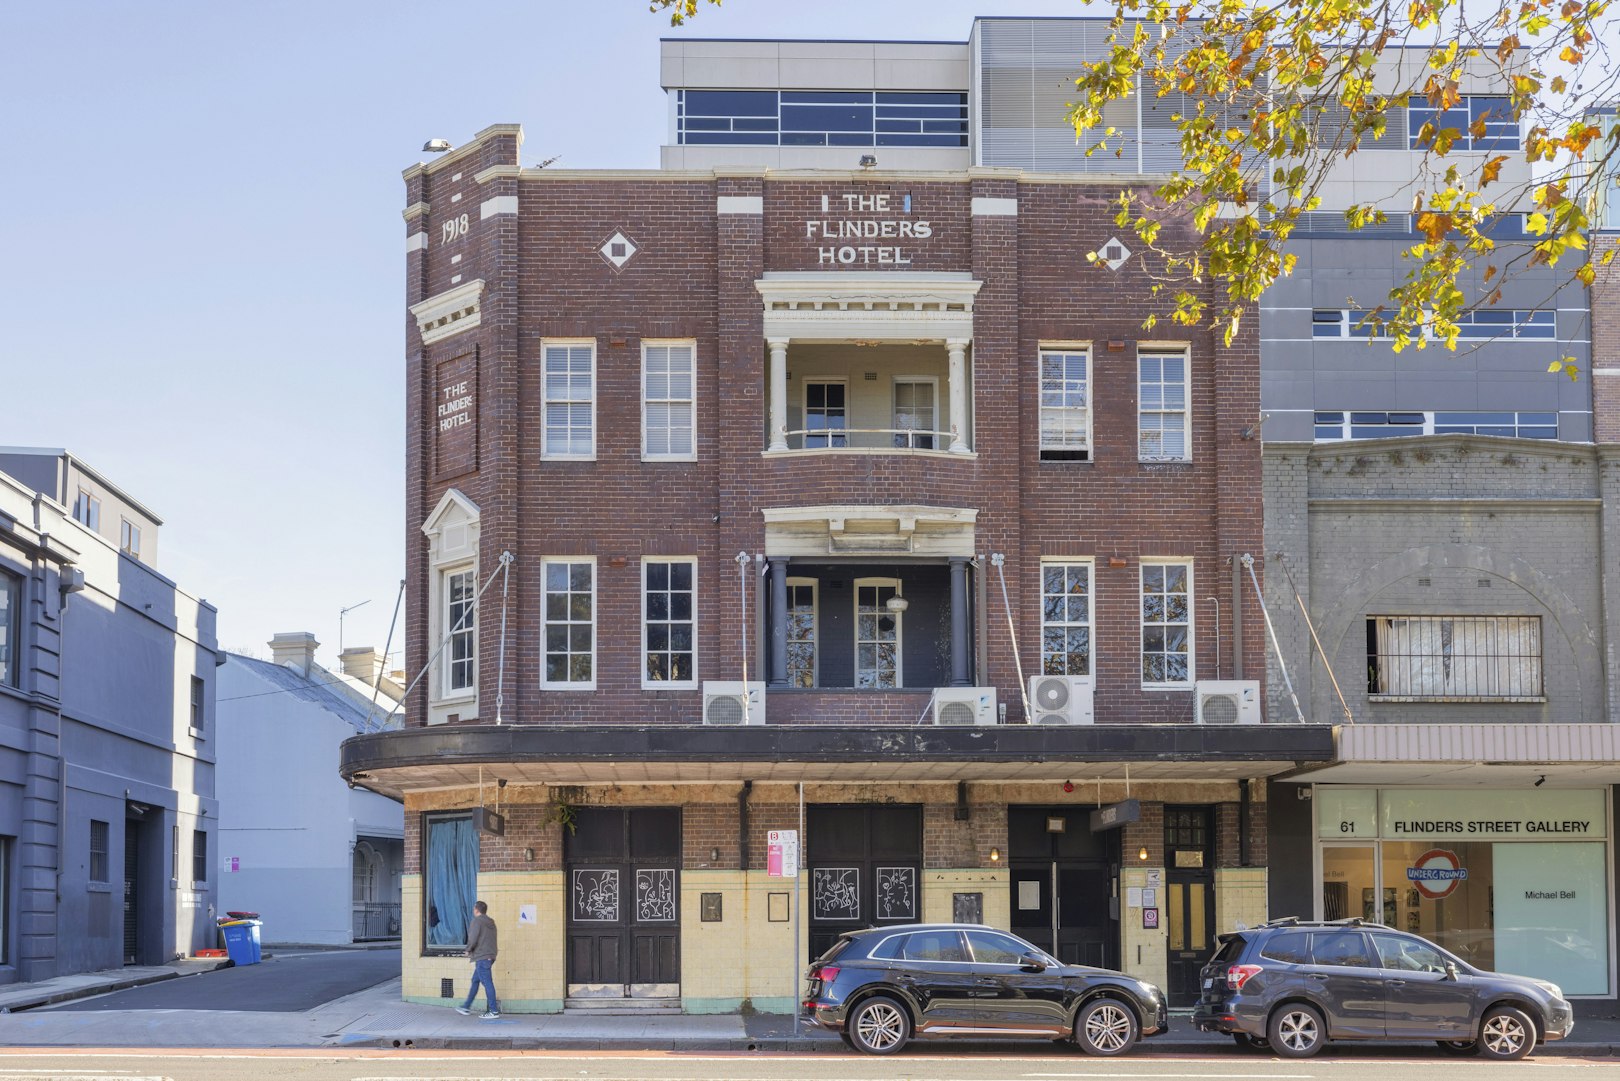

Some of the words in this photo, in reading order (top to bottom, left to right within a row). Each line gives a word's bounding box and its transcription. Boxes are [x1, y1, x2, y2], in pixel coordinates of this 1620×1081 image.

[842, 194, 890, 212] THE
[441, 213, 470, 245] 1918
[806, 220, 933, 239] FLINDERS
[818, 246, 911, 264] HOTEL
[443, 381, 468, 399] THE
[440, 411, 472, 432] HOTEL
[1340, 821, 1355, 833] 61
[1394, 821, 1463, 833] FLINDERS
[1467, 821, 1521, 833] STREET
[1525, 821, 1590, 833] GALLERY
[1408, 869, 1466, 879] UNDERGROUND
[1525, 891, 1557, 899] Michael
[1560, 891, 1576, 899] Bell
